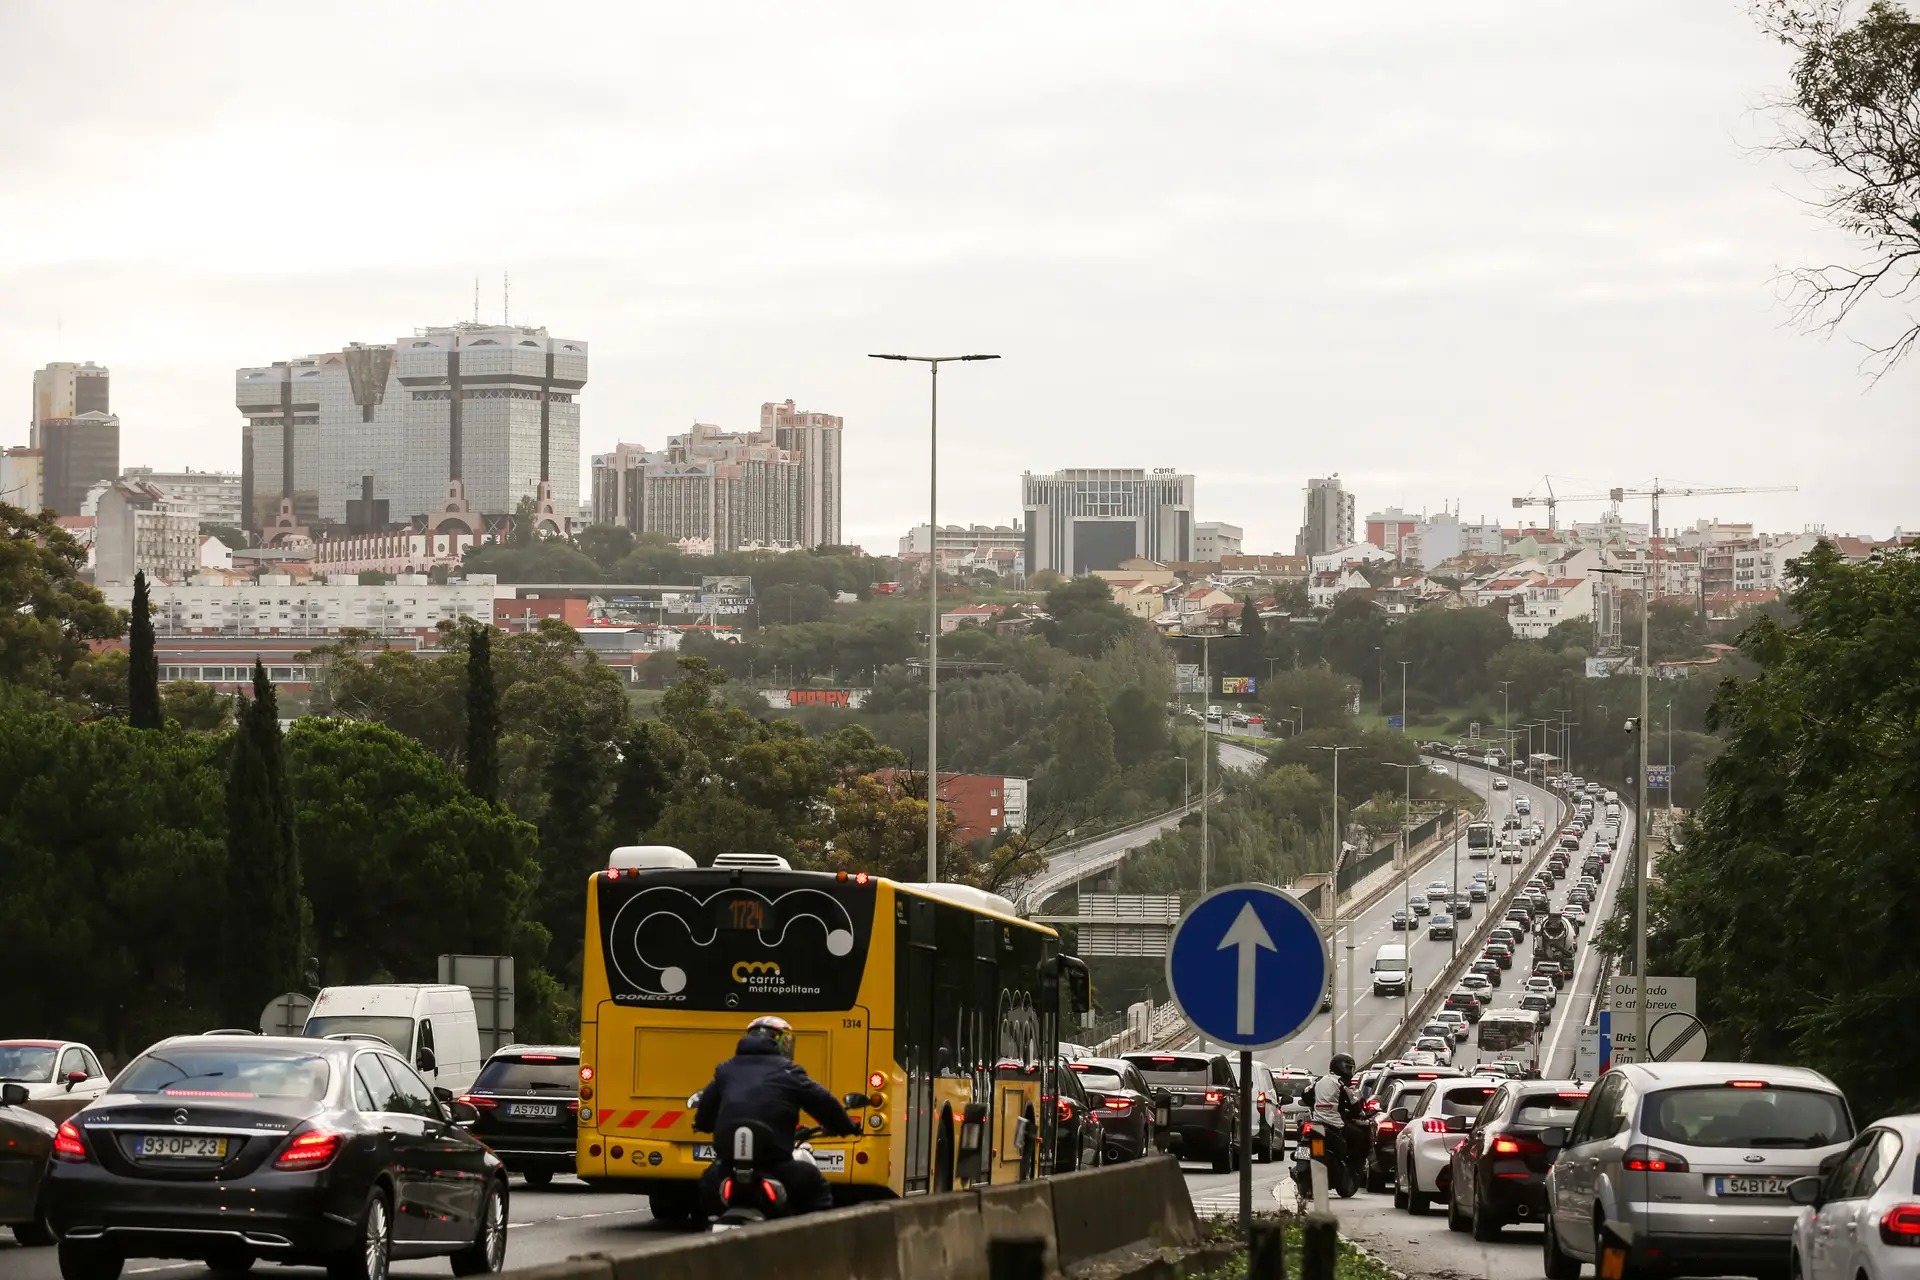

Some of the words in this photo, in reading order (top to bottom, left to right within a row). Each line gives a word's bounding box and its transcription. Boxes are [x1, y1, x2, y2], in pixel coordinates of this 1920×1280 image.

[728, 899, 764, 929] 1724
[749, 974, 785, 984] carris
[749, 985, 821, 995] metropolitana
[1615, 984, 1667, 996] Obrado
[615, 993, 687, 1001] CONECTO
[1615, 1001, 1623, 1009] e
[1625, 1000, 1637, 1010] at
[1645, 1000, 1677, 1009] breve
[841, 1018, 862, 1029] 1314
[1615, 1032, 1637, 1043] Bris
[1615, 1053, 1633, 1063] Fim
